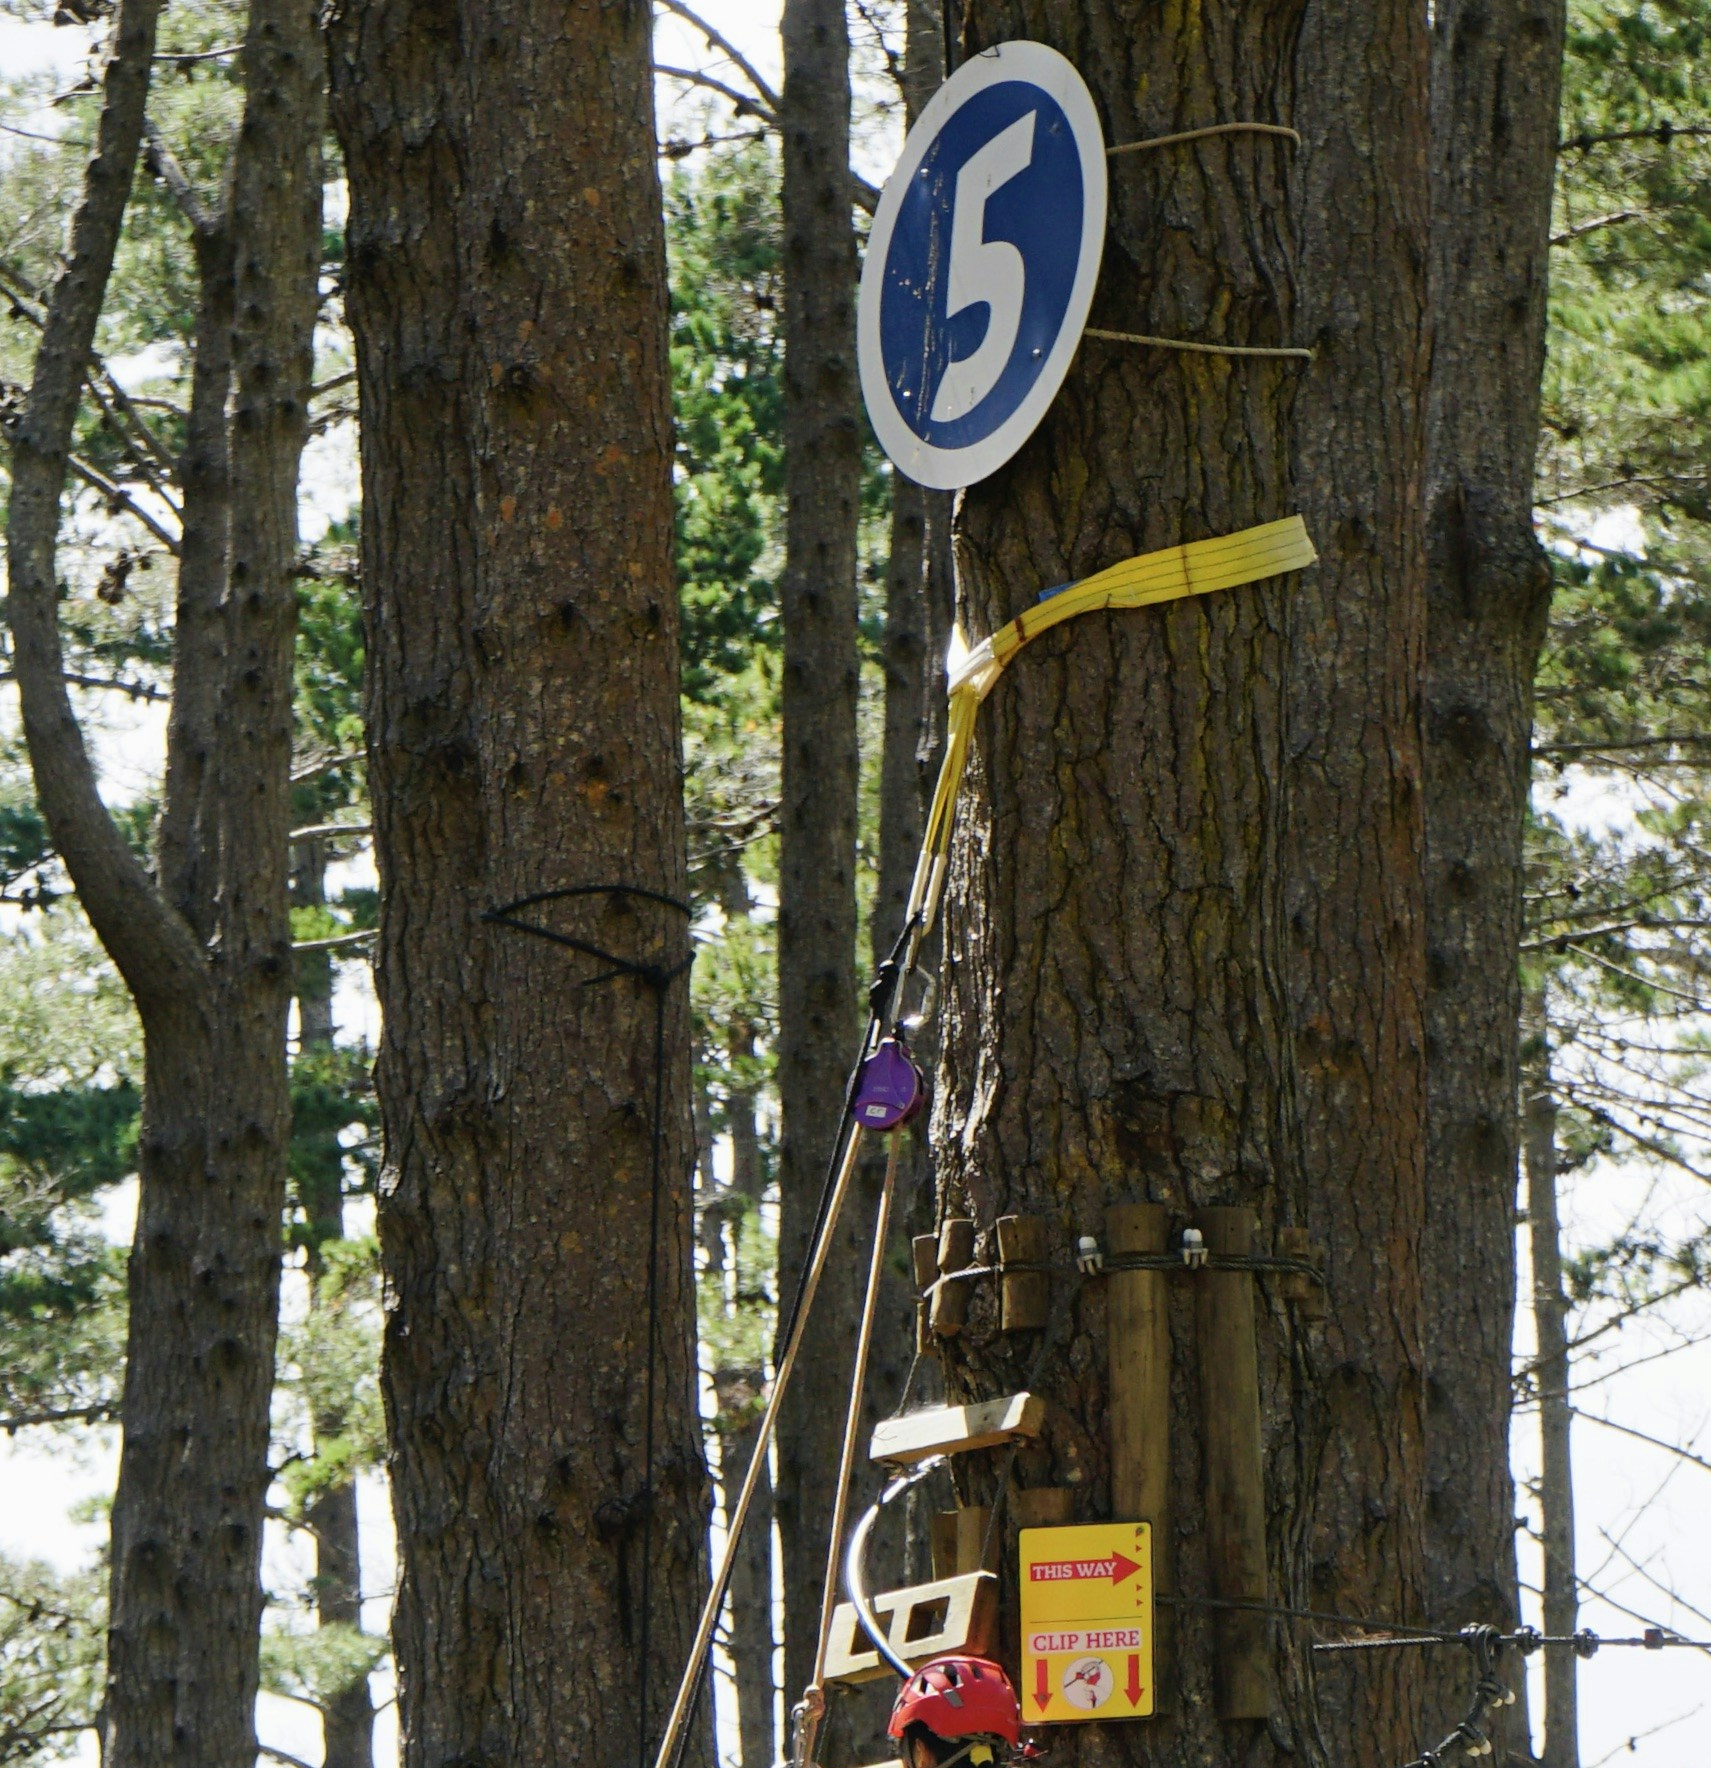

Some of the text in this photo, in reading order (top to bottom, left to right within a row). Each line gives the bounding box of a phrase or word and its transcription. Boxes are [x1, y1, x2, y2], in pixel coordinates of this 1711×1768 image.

[930, 109, 1037, 422] 5
[1033, 1561, 1117, 1580] THIS WAY
[1033, 1630, 1140, 1652] CLIP HERE
